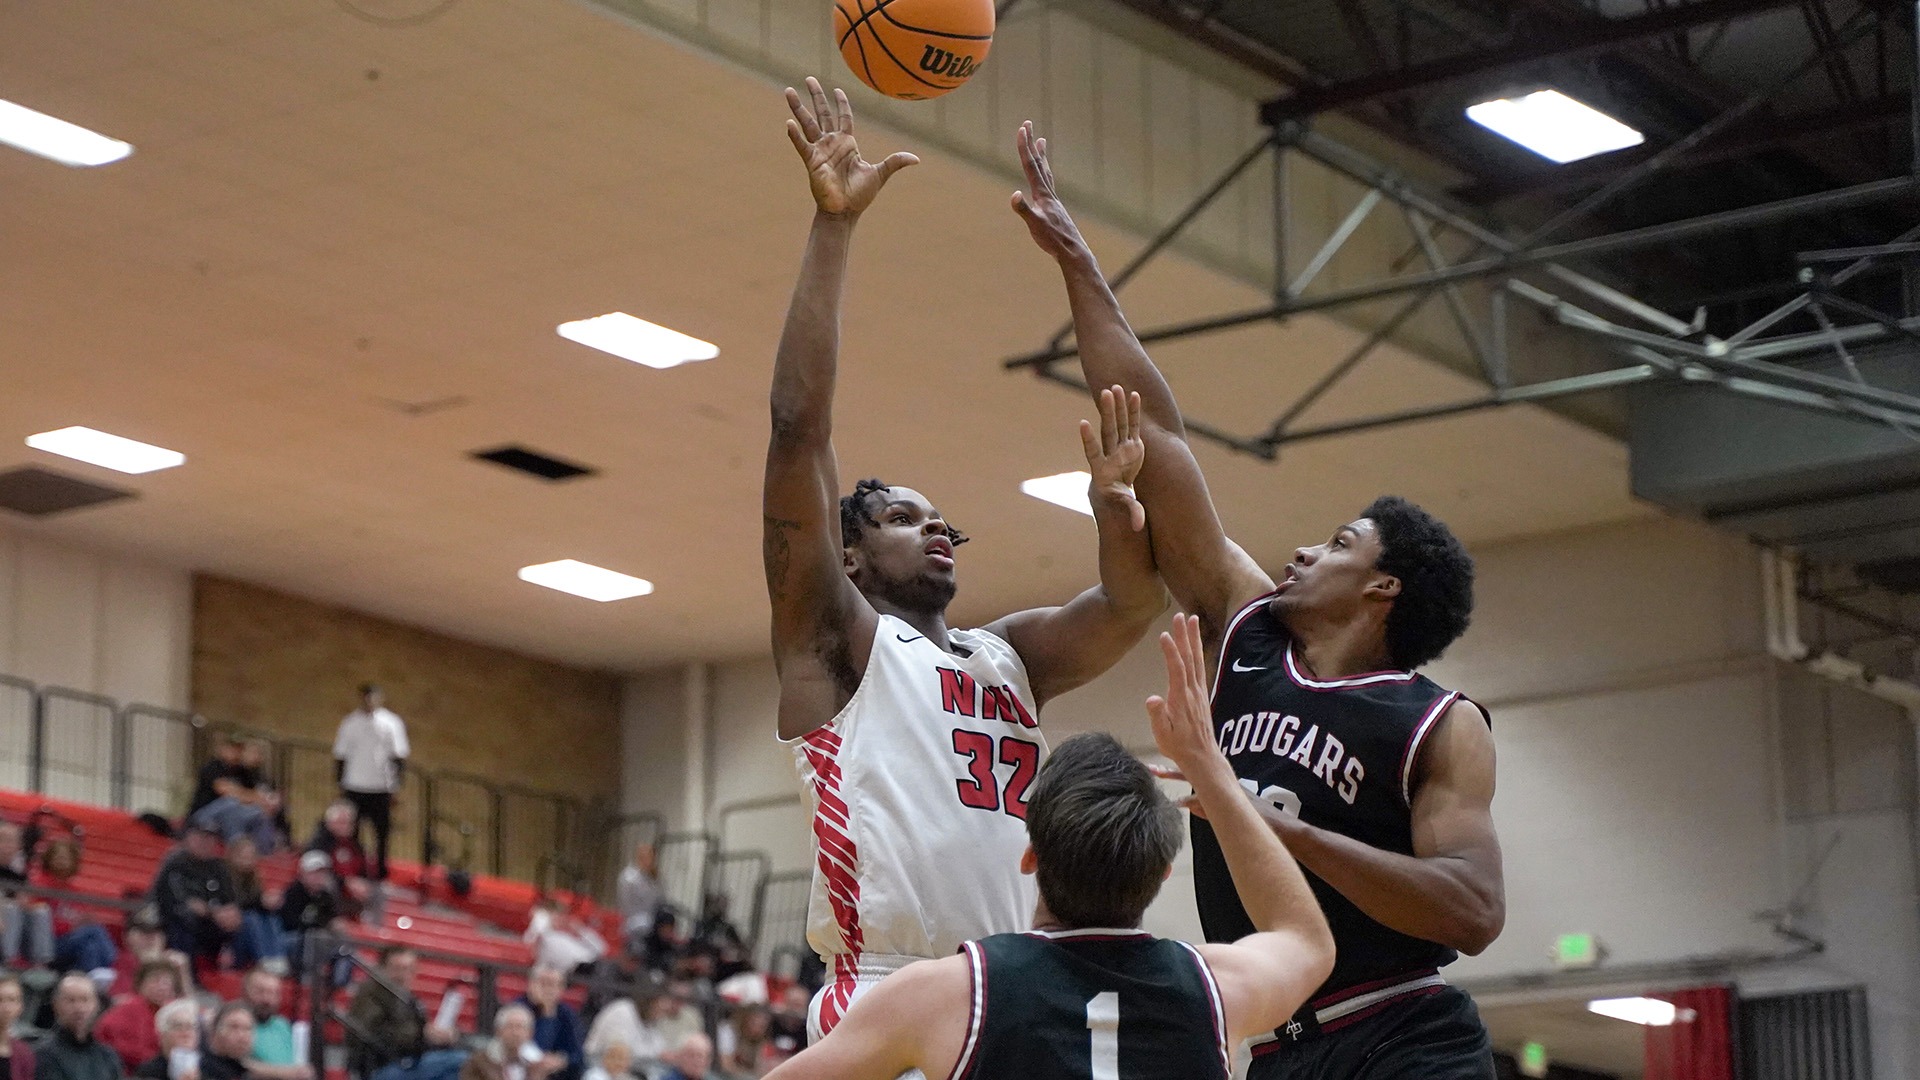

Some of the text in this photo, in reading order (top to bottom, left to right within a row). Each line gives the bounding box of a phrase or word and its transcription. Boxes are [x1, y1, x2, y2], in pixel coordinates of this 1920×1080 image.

[952, 728, 1040, 822] 32
[1219, 711, 1365, 805] COUGARS
[1086, 991, 1120, 1080] 1
